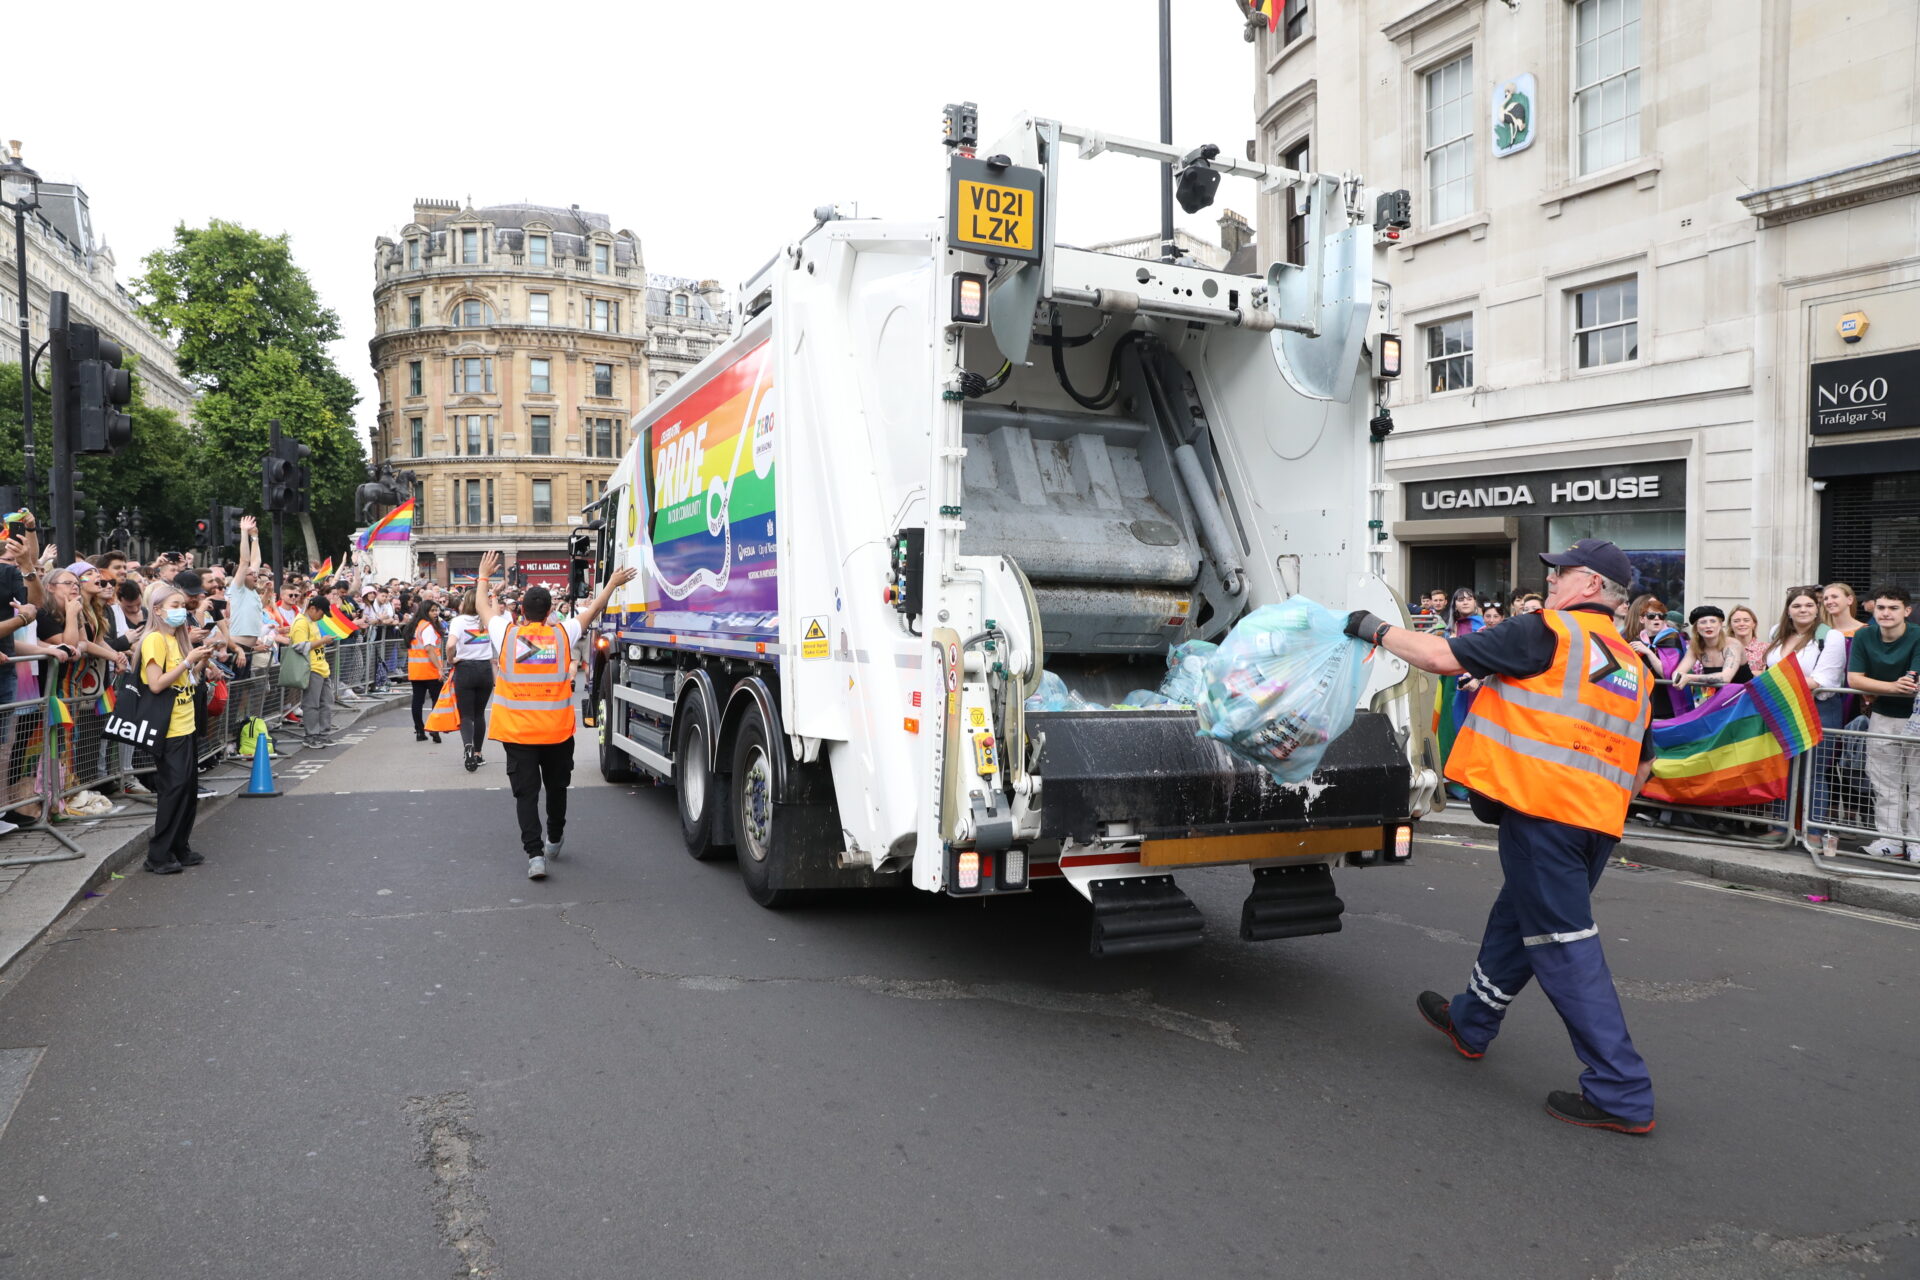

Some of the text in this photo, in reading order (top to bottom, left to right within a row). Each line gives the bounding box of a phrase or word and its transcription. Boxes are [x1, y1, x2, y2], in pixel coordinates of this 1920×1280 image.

[971, 185, 1022, 217] VO21
[973, 214, 1019, 244] LZK
[756, 411, 774, 438] ZERO
[1818, 409, 1887, 425] Trafalgar Sq
[654, 421, 708, 513] PRIDE
[1422, 475, 1660, 511] UGANDA HOUSE
[1613, 675, 1637, 691] PROUD
[1625, 672, 1637, 682] ARE
[104, 714, 157, 746] ual:
